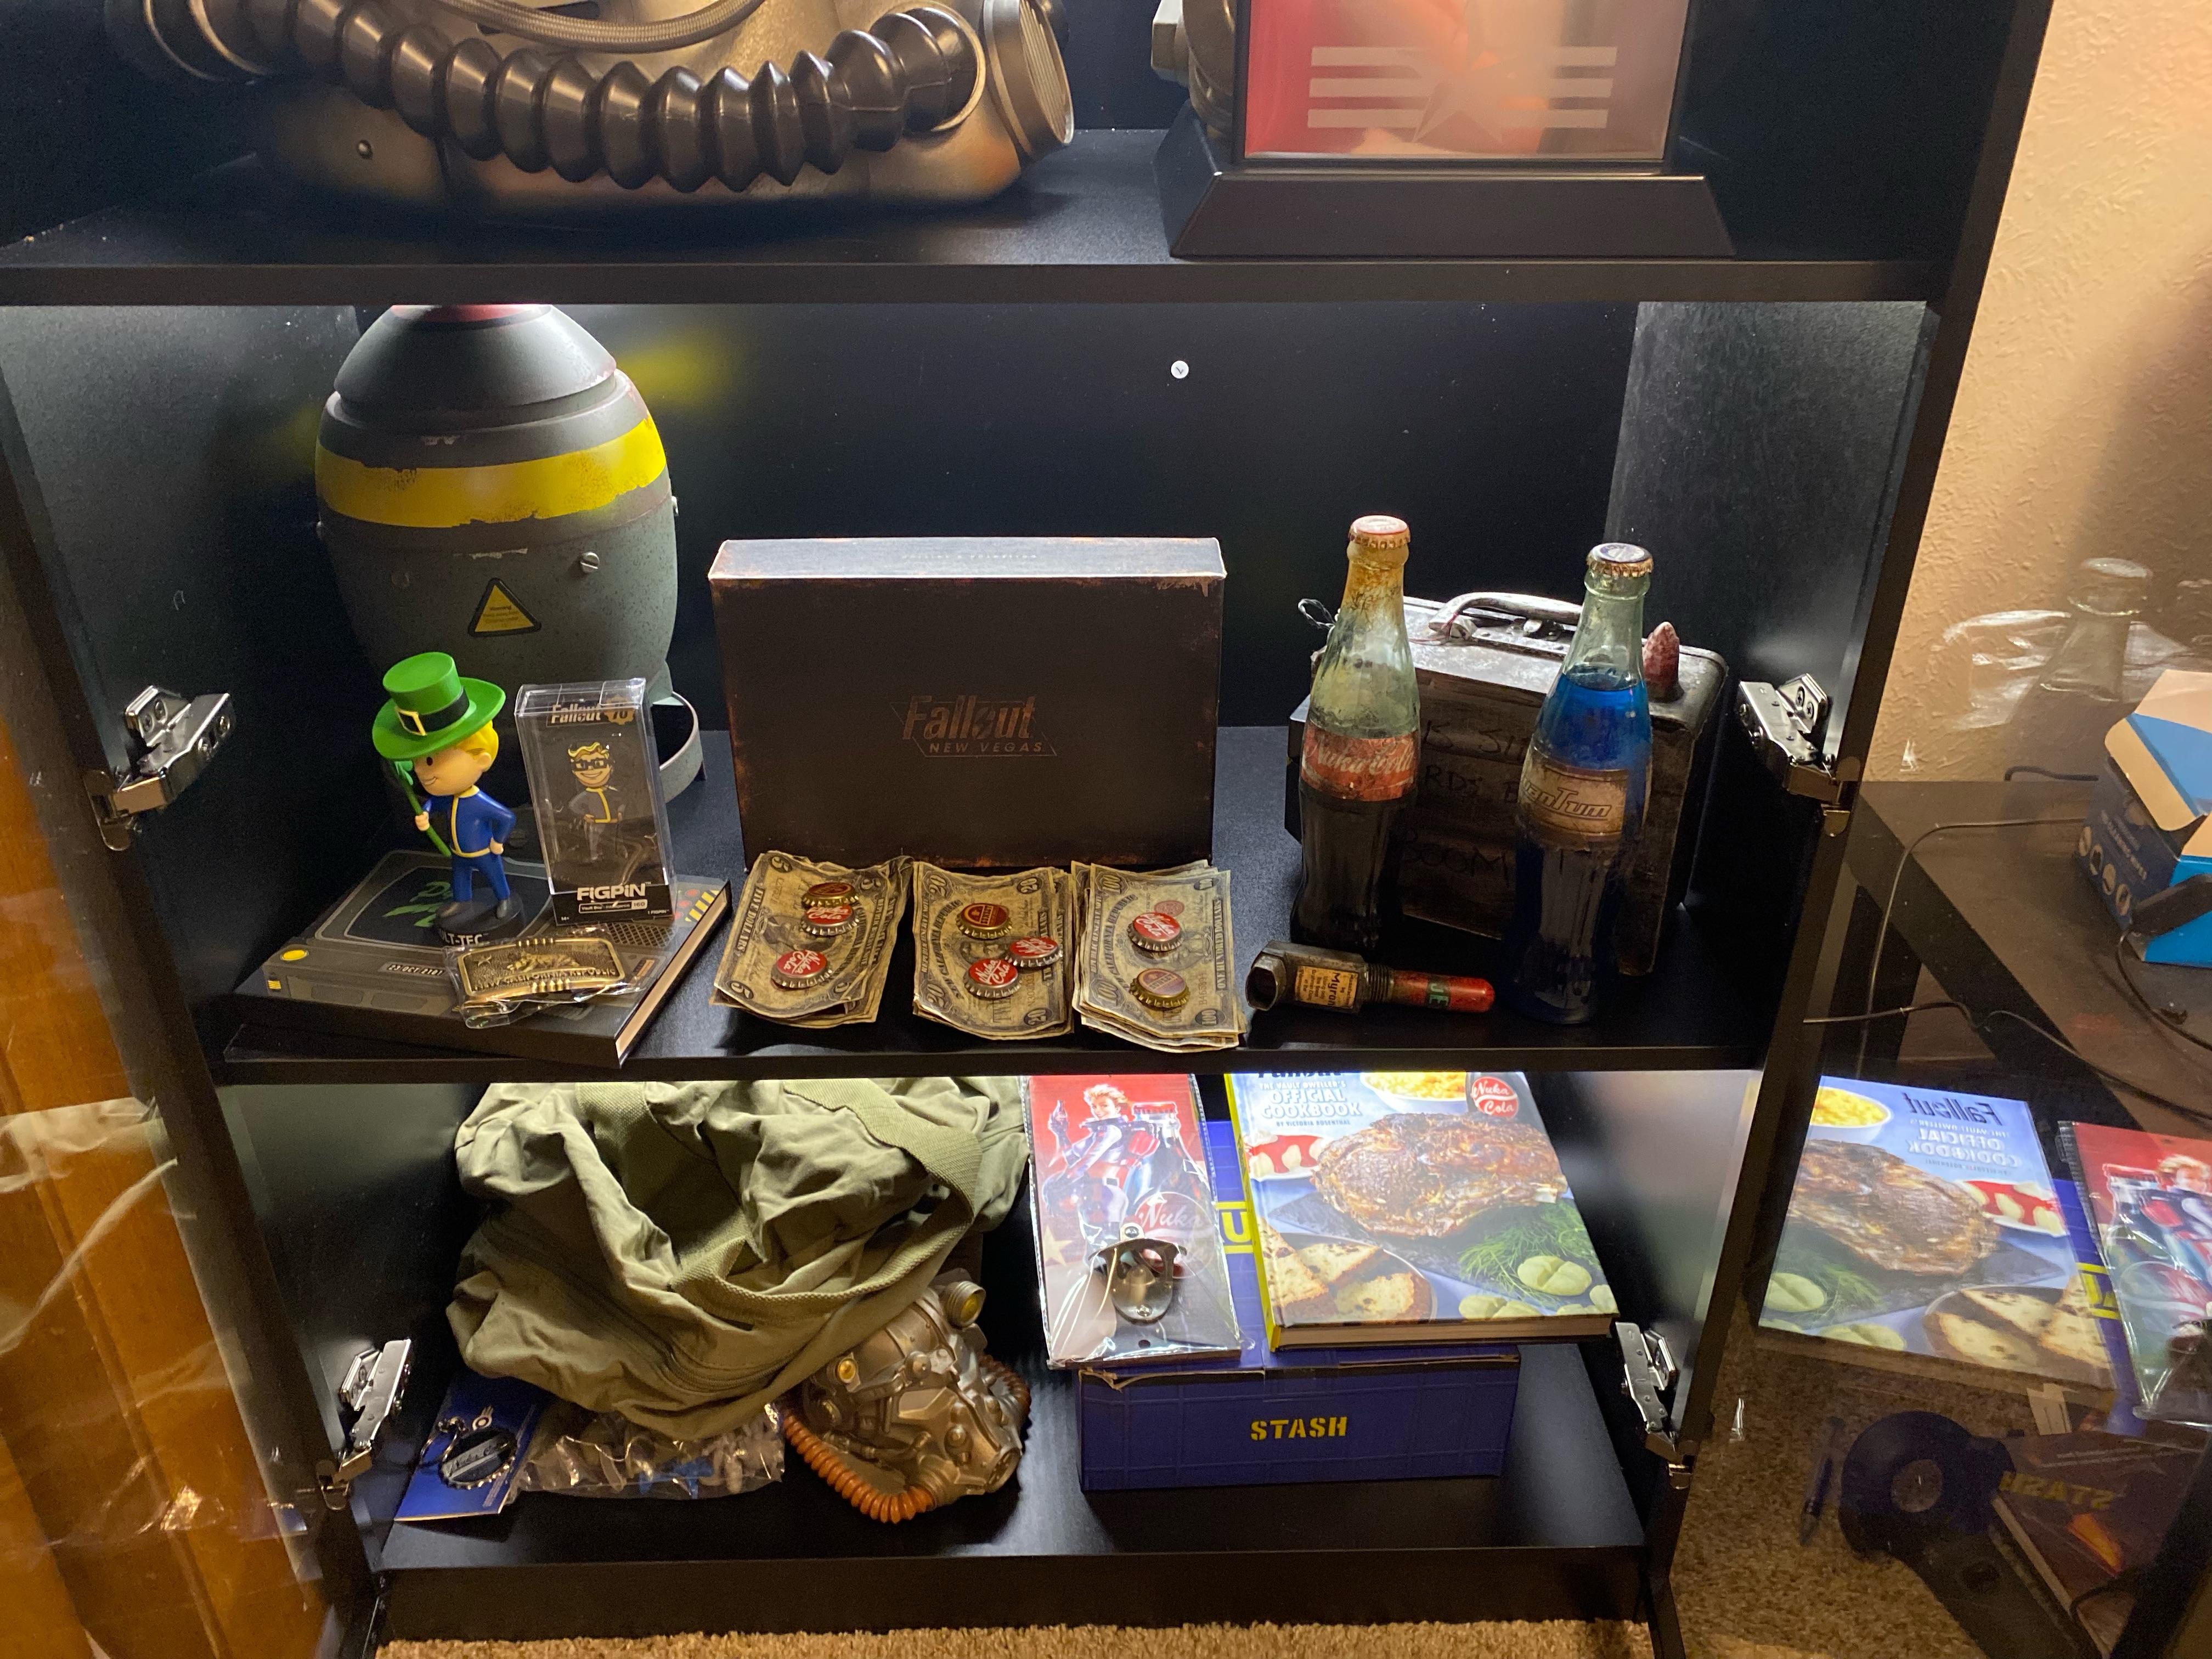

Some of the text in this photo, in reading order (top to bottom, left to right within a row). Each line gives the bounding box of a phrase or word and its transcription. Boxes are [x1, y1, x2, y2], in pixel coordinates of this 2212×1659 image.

[550, 704, 602, 724] Fallout
[902, 695, 1036, 740] Fallout
[930, 742, 1042, 753] NEW VEGAS
[1522, 776, 1612, 817] uanTum
[771, 856, 791, 872] 5
[928, 875, 947, 899] 20
[1021, 878, 1038, 893] 20
[1102, 874, 1121, 894] 100
[808, 912, 842, 920] Cola
[934, 899, 963, 930] REPUBLIC
[1107, 894, 1139, 924] REPUBLIC
[737, 887, 764, 952] FIVE DOLLARS
[1104, 924, 1120, 975] CALIFORNIA
[1213, 899, 1226, 989] ONE HUNDRED DOLLARS
[784, 951, 802, 970] Cola
[797, 949, 821, 974] Nuka
[569, 967, 616, 977] REPUBLIC
[975, 960, 998, 983] Nuka
[992, 964, 1010, 984] Cola
[1149, 973, 1178, 990] SUNSET
[731, 983, 750, 998] 5
[927, 983, 945, 1008] 20
[1097, 981, 1118, 1005] 100
[1327, 972, 1341, 1006] Myron
[1028, 1008, 1046, 1025] 20
[1202, 1009, 1217, 1026] 100
[1276, 1081, 1300, 1090] VAULT
[1302, 1080, 1347, 1089] DWELLER'S
[1472, 1080, 1509, 1099] Nuka
[1269, 1089, 1347, 1104] OFFICIAL
[1262, 1102, 1363, 1119] COOKBOOK
[1484, 1100, 1514, 1115] Cola
[1140, 1203, 1205, 1229] Nuka
[1250, 1415, 1349, 1442] STASH
